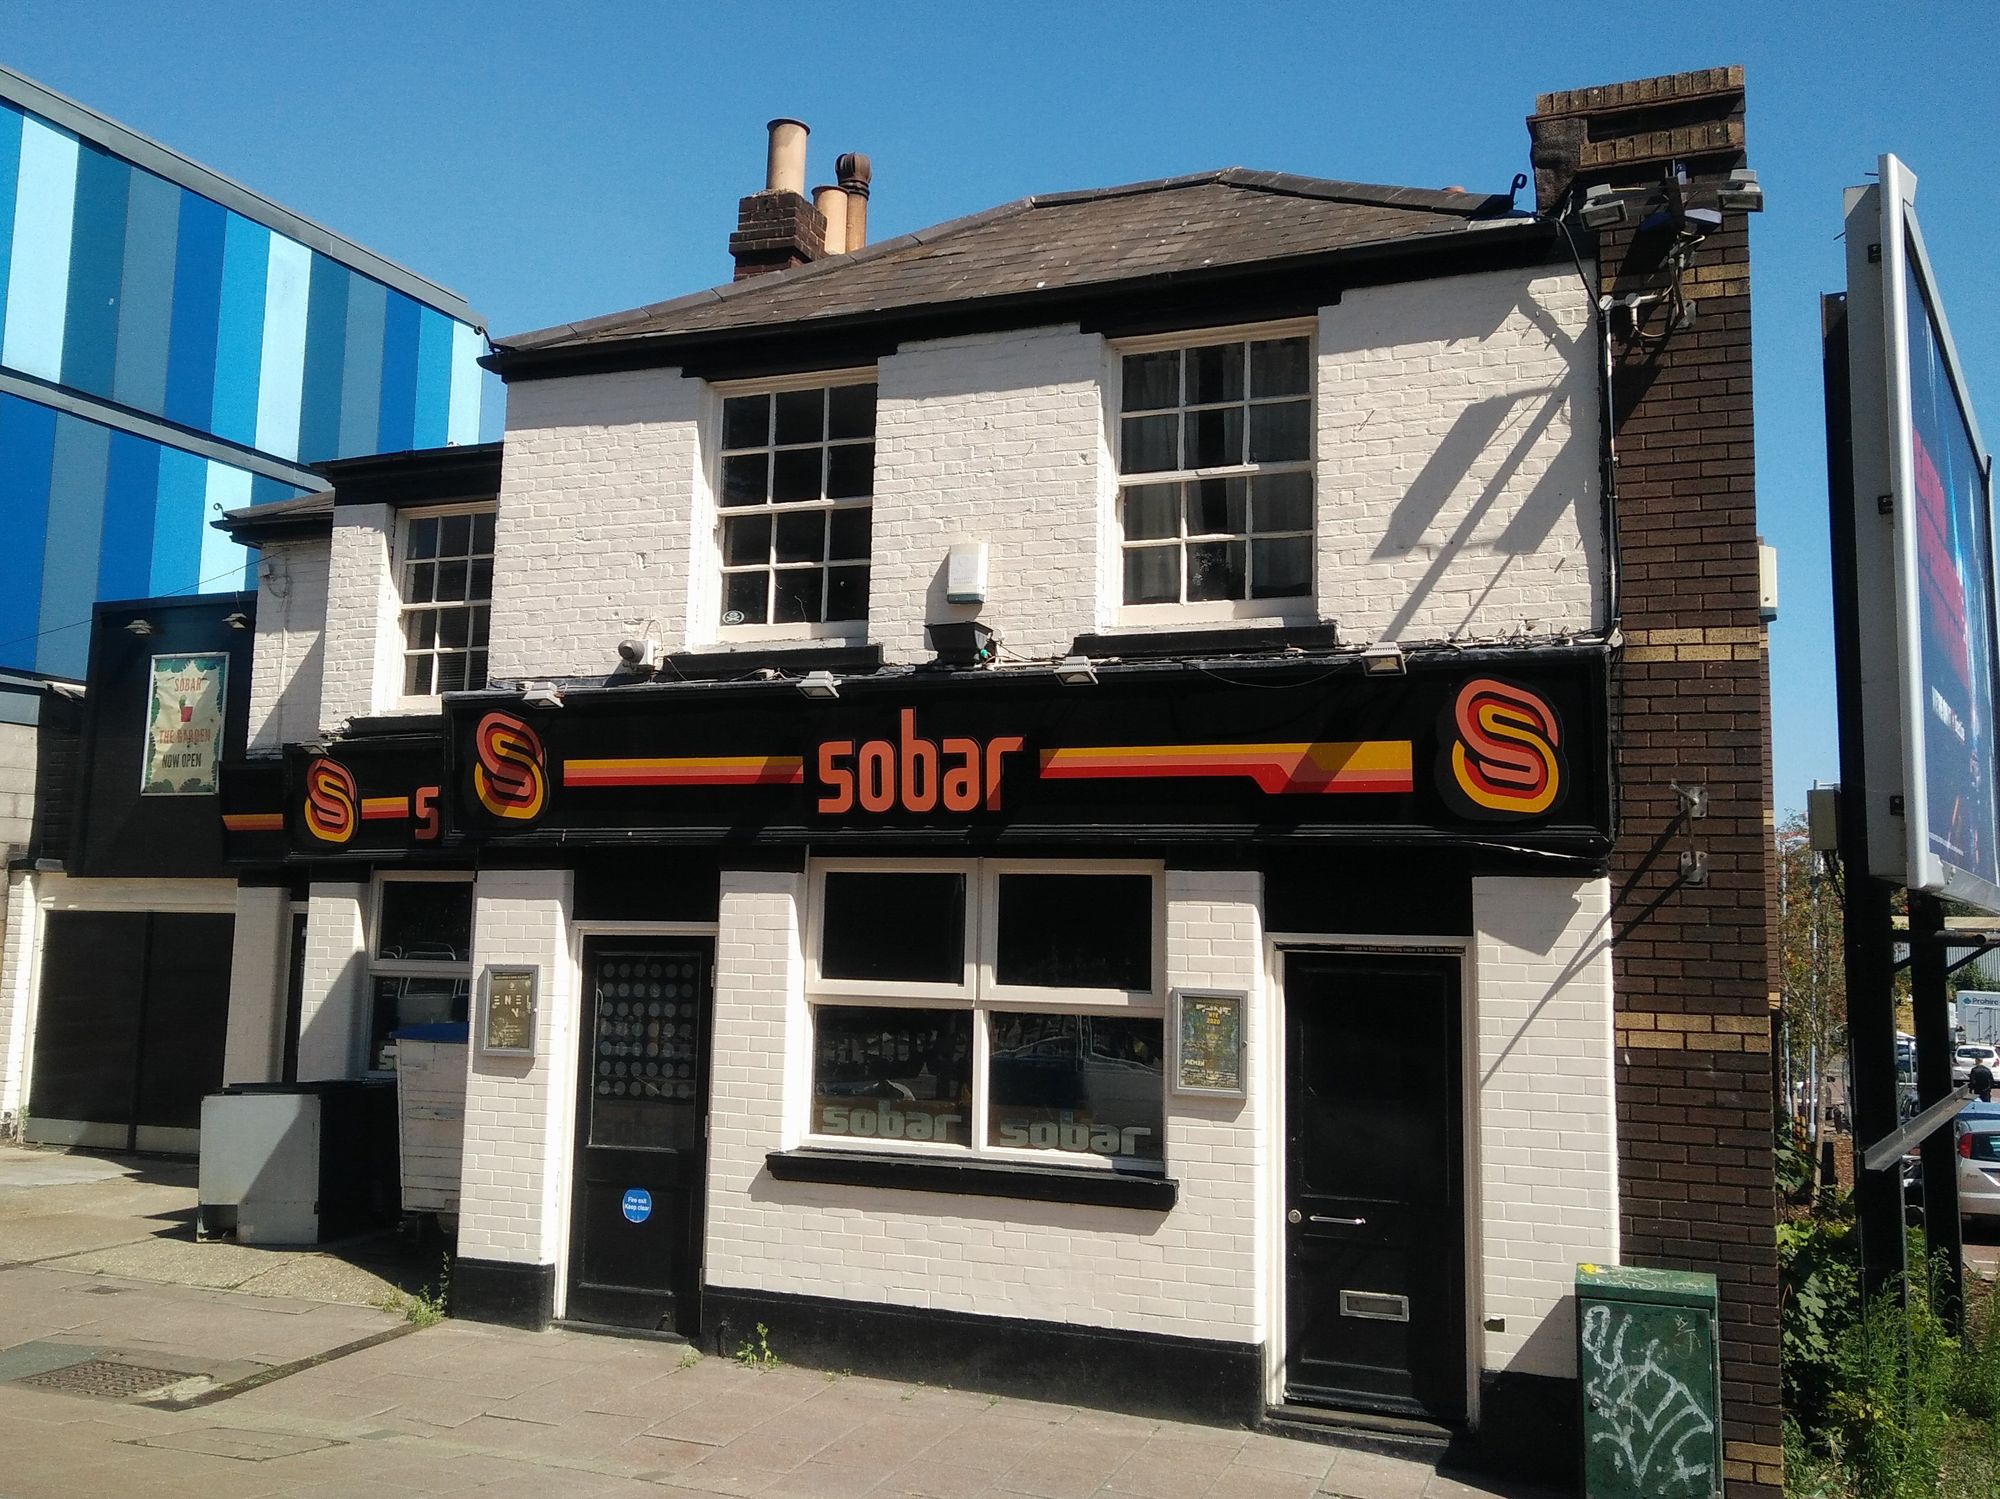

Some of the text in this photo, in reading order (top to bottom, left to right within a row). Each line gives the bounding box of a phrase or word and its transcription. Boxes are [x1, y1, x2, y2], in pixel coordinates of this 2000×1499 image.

[175, 677, 202, 692] SOBAR
[159, 729, 174, 744] THE
[162, 752, 202, 769] NOW OPEN
[818, 707, 1025, 814] sobar
[1972, 997, 1999, 1005] Prohire
[822, 1100, 962, 1143] sobar
[1000, 1110, 1152, 1155] sobar
